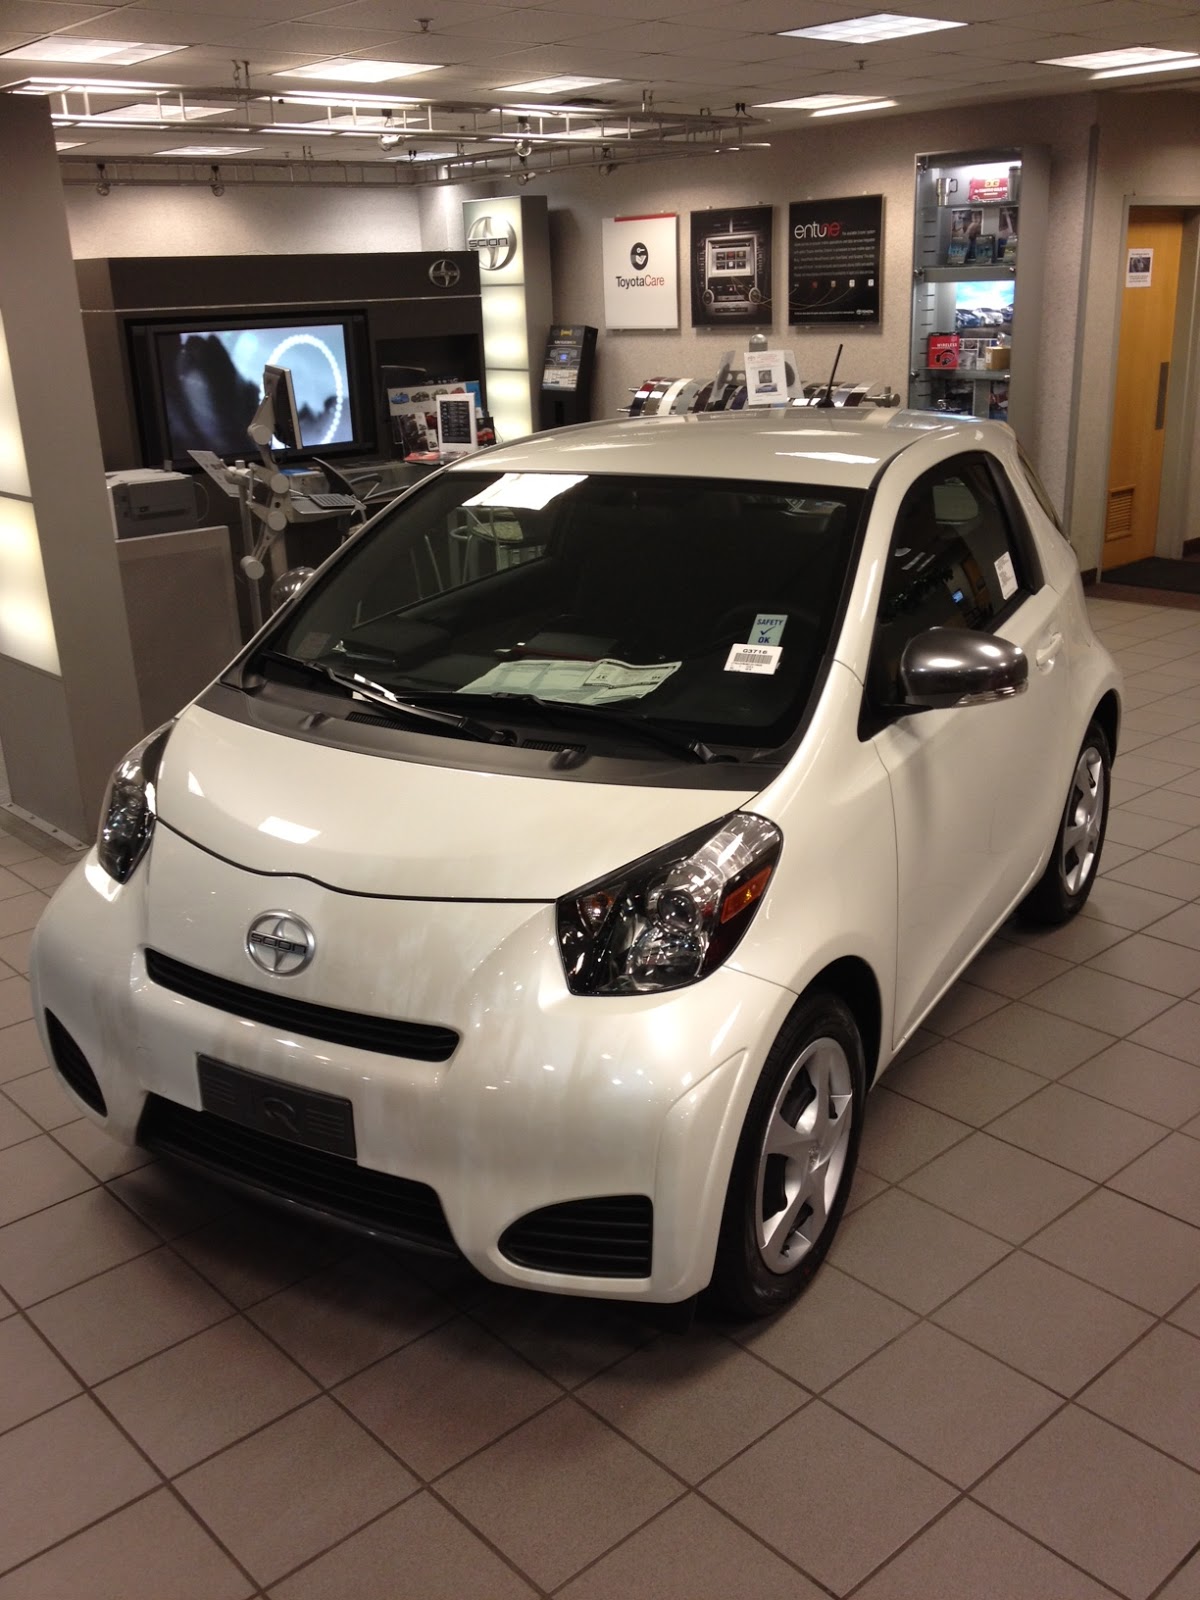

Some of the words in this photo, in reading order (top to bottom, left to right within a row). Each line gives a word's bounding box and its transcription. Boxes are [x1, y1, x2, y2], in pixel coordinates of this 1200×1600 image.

[794, 221, 840, 239] entune
[615, 274, 665, 289] ToyotaCare
[756, 618, 784, 626] SAFETY
